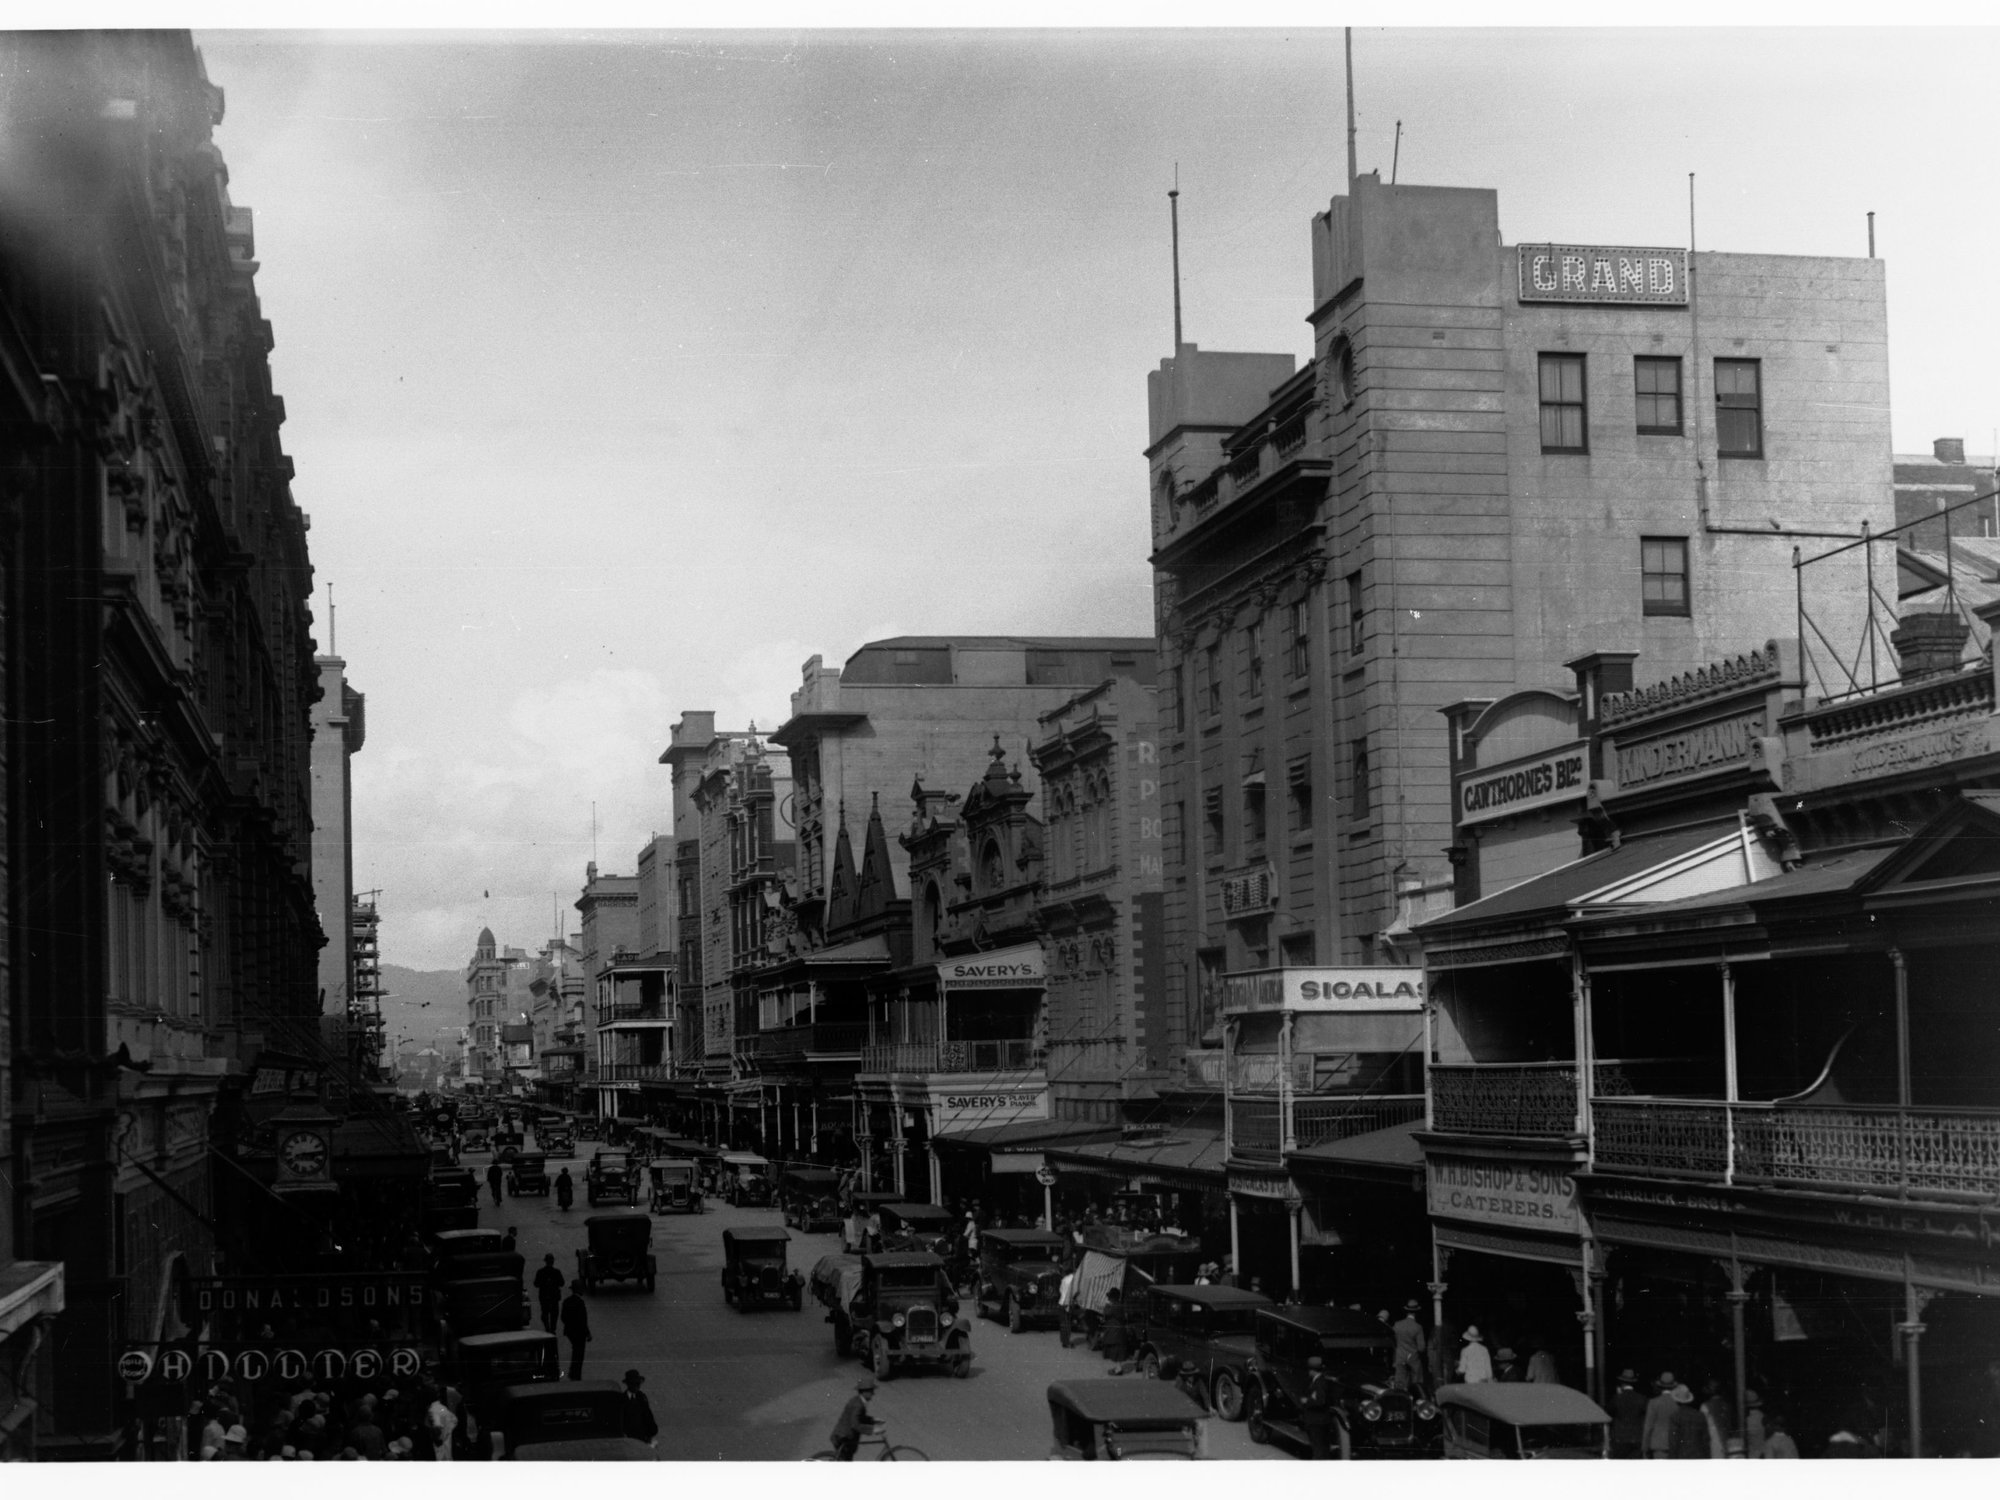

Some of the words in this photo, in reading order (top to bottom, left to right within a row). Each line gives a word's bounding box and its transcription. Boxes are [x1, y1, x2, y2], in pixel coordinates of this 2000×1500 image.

[1533, 255, 1674, 294] GRAND
[1464, 763, 1553, 812] CAWTHORNE'S
[1515, 1169, 1524, 1192] &
[1528, 1166, 1573, 1197] SONS
[162, 1350, 414, 1381] HILLIER
